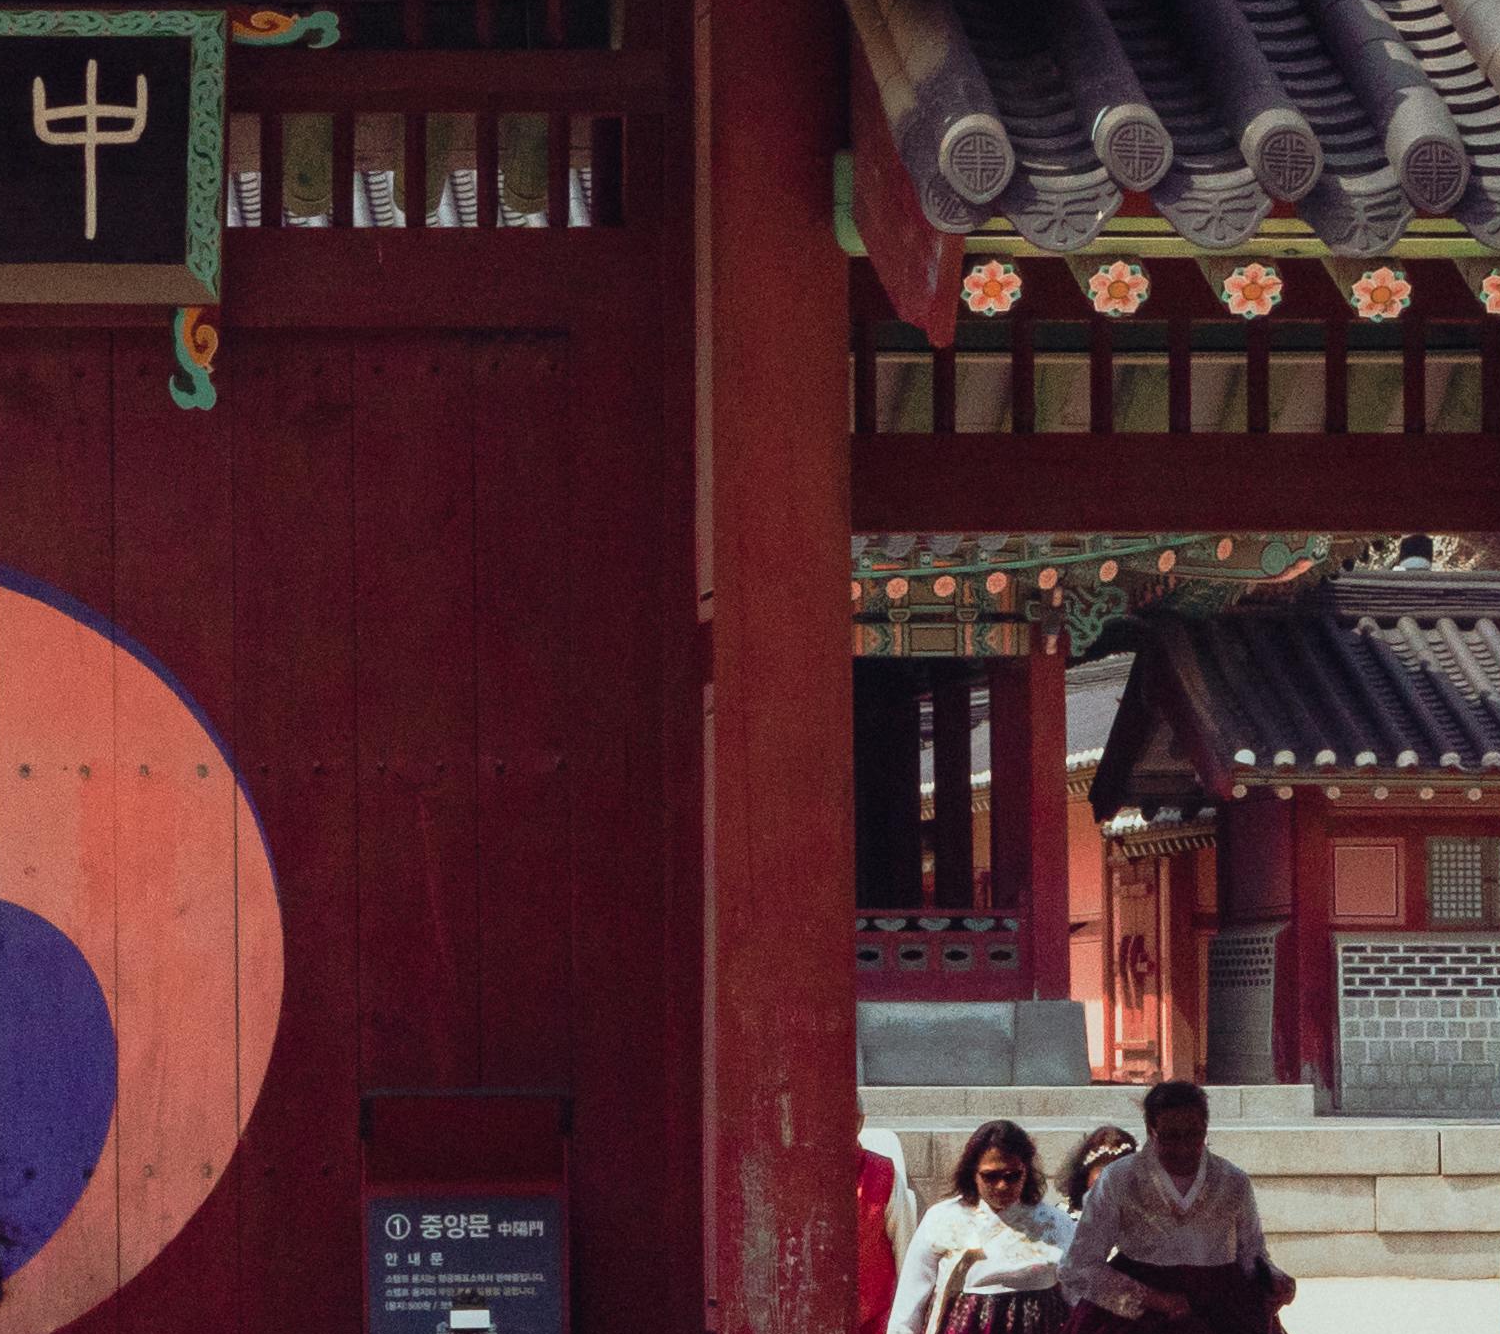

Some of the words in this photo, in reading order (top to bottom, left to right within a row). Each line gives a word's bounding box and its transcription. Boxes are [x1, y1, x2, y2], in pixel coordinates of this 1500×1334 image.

[420, 1213, 492, 1239] 중양문
[497, 1220, 544, 1237] 中陽門
